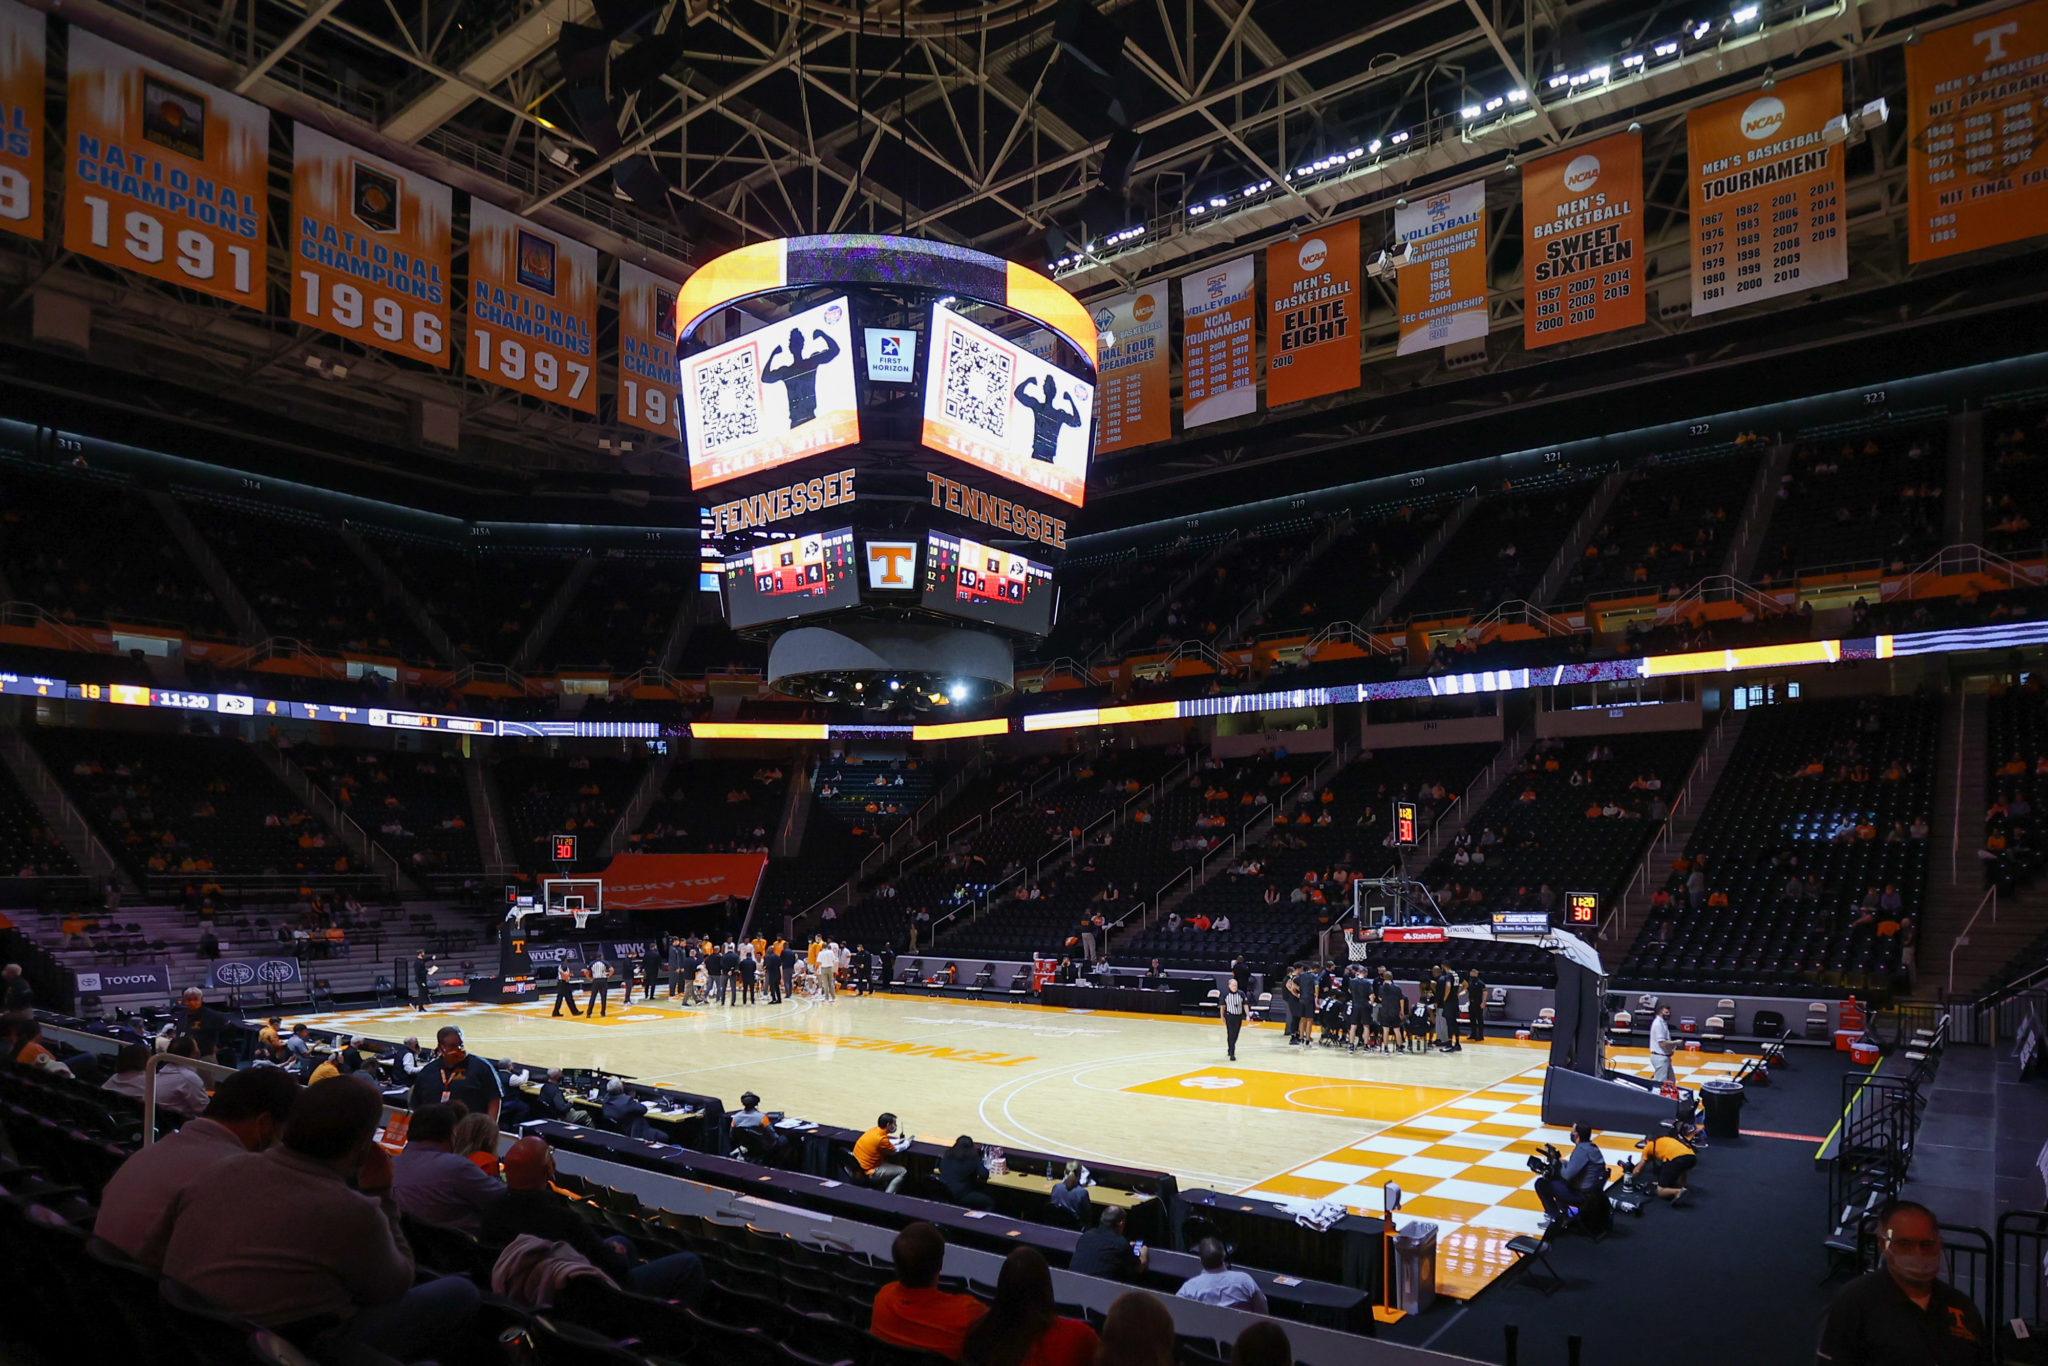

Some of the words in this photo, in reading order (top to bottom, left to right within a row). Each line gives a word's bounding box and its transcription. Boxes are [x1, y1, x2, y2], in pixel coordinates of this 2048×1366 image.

[1972, 21, 2018, 63] T
[1745, 113, 1784, 132] NCAA
[1703, 155, 1741, 176] MEN'S
[1704, 149, 1828, 201] TOURNAMENT
[78, 134, 259, 218] NATIONAL
[1568, 168, 1600, 186] NCAA
[1971, 179, 2014, 198] FINAL
[77, 159, 258, 239] CHAMPIONS
[1557, 193, 1606, 217] MEN'S
[1736, 203, 1759, 217] 1982
[1772, 194, 1797, 207] 2001
[1810, 182, 1835, 196] 2011
[1402, 212, 1480, 241] VOLLEYBALL
[1533, 201, 1632, 239] BASKETBALL
[1773, 223, 1798, 237] 2007
[84, 195, 250, 294] 1991
[1421, 228, 1478, 252] TOURNAMENT
[1545, 224, 1620, 261] SWEET
[302, 216, 443, 285] NATIONAL
[1408, 239, 1476, 266] HAMPIONSHIPS
[1430, 258, 1449, 271] 1981
[1535, 240, 1632, 282] SIXTEEN
[301, 238, 442, 304] CHAMPIONS
[1430, 268, 1450, 281] 1982
[1293, 272, 1331, 293] MEN'S
[1430, 278, 1451, 292] 1984
[1536, 287, 1561, 302] 1967
[1568, 278, 1596, 294] 2007
[1603, 270, 1630, 285] 2014
[1703, 287, 1724, 300] 1981
[1737, 278, 1762, 293] 2000
[1774, 269, 1799, 283] 2010
[1186, 290, 1250, 316] VOLLEYBALL
[1274, 280, 1351, 312] BASKETBALL
[1428, 289, 1452, 303] 2004
[1536, 302, 1560, 317] 1981
[1568, 294, 1595, 309] 2008
[1603, 284, 1630, 300] 2019
[300, 270, 443, 354] 1996
[475, 280, 591, 338] NATIONAL
[1285, 299, 1345, 332] ELITE
[1419, 295, 1484, 320] CHAMPIONSHIP
[475, 301, 591, 356] CHAMPIONS
[1204, 311, 1232, 328] NCAA
[1536, 317, 1563, 332] 2000
[1570, 309, 1595, 324] 2010
[1185, 317, 1252, 346] TOURNAMENT
[1281, 318, 1348, 352] EIGHT
[1126, 337, 1154, 354] FOUR
[474, 329, 590, 400] 1997
[872, 364, 909, 372] HORIZON
[1272, 355, 1294, 369] 2010
[1863, 391, 1886, 405] 323
[1689, 423, 1710, 436] 322
[58, 438, 82, 451] 313
[947, 434, 996, 465] SCAN
[1544, 452, 1561, 463] 321
[240, 478, 261, 490] 314
[1409, 476, 1425, 488] 320
[711, 468, 856, 534] TENNESSEE
[927, 471, 1067, 550] TENNESSEE
[784, 554, 790, 564] 1
[870, 546, 912, 584] T
[990, 561, 996, 571] 1
[809, 565, 818, 580] 4
[961, 569, 976, 586] 19
[758, 576, 773, 592] 19
[978, 581, 984, 590] 4
[1011, 584, 1018, 598] 4
[38, 685, 47, 696] 4
[80, 683, 101, 699] 19
[120, 687, 141, 704] T
[160, 692, 210, 709] 11:20
[266, 702, 276, 715] 4
[338, 713, 347, 722] 4
[1400, 819, 1413, 842] 30
[556, 845, 573, 858] 30
[680, 876, 726, 887] TOP
[1573, 897, 1595, 907] 11:20
[1574, 907, 1591, 921] 30
[512, 940, 526, 954] T
[104, 974, 157, 985] TOYOTA
[1414, 1007, 1424, 1017] 41
